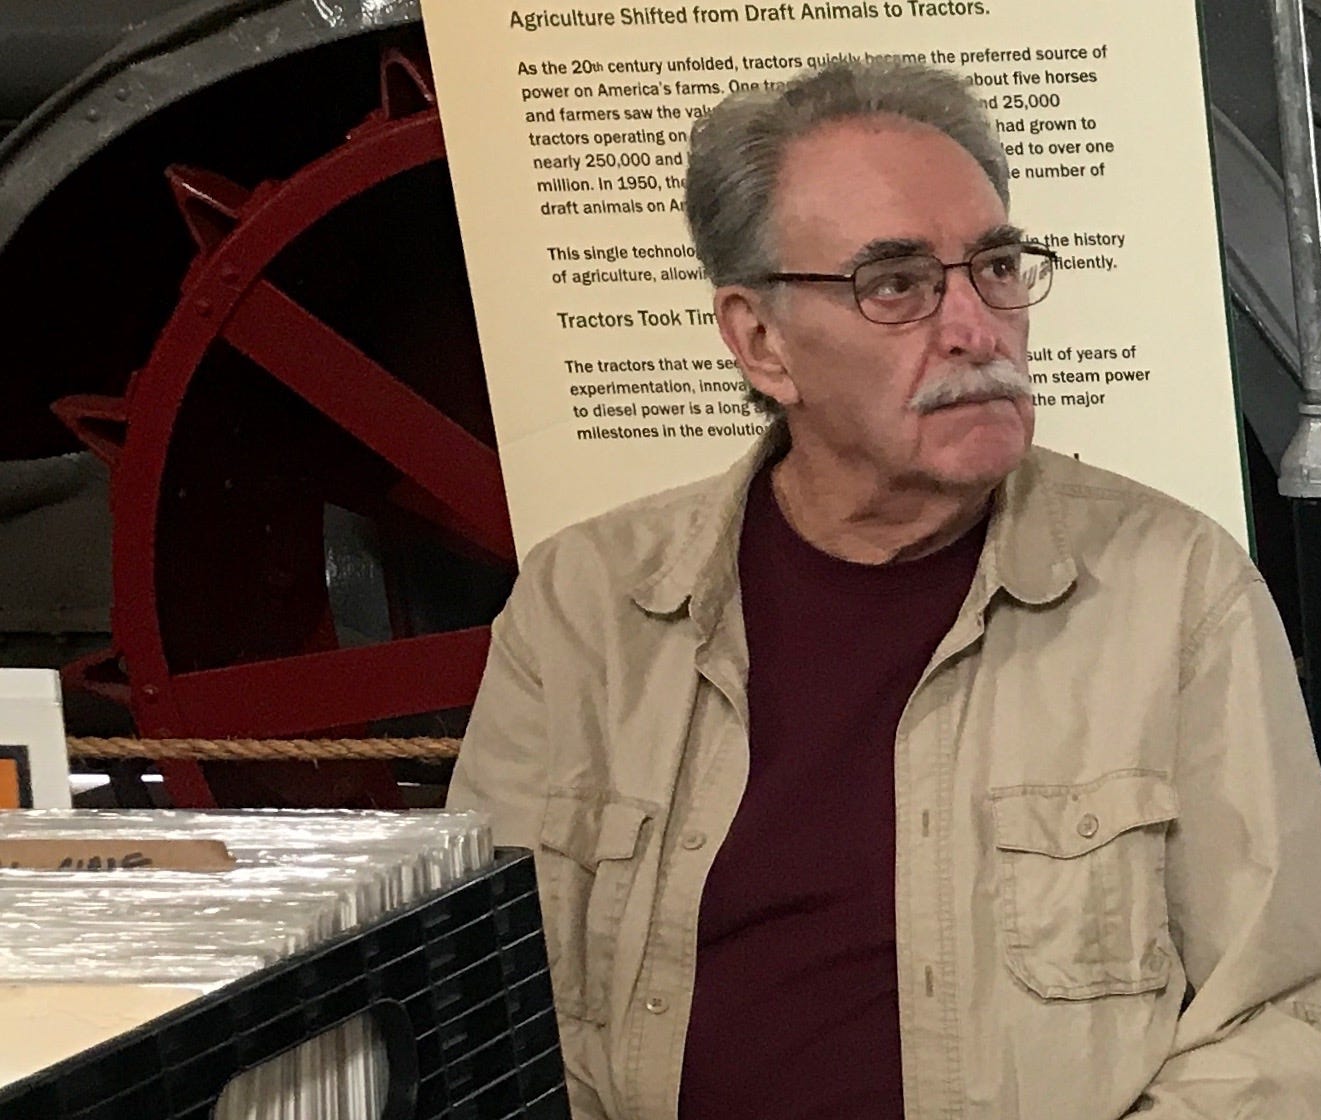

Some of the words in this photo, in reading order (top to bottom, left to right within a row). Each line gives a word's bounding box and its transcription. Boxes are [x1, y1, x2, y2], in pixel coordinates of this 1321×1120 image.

[510, 9, 615, 32] Agriculture
[620, 7, 687, 25] Shifted
[693, 6, 739, 23] from
[745, 3, 795, 21] Draft
[801, 1, 878, 20] Animals
[883, 2, 902, 17] to
[907, 0, 990, 16] Tractors.
[518, 62, 538, 75] As
[541, 61, 567, 75] the
[571, 60, 603, 74] 20th
[608, 60, 662, 75] century
[667, 56, 738, 72] unfolded,
[742, 56, 802, 70] tractors
[930, 50, 955, 64] the
[960, 47, 1031, 66] preferred
[1036, 48, 1087, 60] source
[1092, 44, 1107, 59] of
[522, 88, 569, 102] power
[574, 87, 593, 98] on
[598, 81, 672, 97] America's
[675, 81, 724, 95] farms.
[729, 80, 759, 94] One
[1012, 71, 1040, 85] five
[1045, 70, 1097, 84] horses
[526, 108, 555, 122] and
[559, 108, 620, 122] farmers
[624, 109, 652, 120] saw
[657, 105, 681, 119] the
[1003, 94, 1060, 110] 25,000
[529, 132, 589, 146] tractors
[594, 129, 665, 146] operating
[669, 132, 688, 142] on
[995, 119, 1025, 133] had
[1030, 119, 1077, 135] grown
[1081, 117, 1096, 130] to
[533, 155, 580, 171] nearly
[585, 153, 650, 168] 250,000
[656, 152, 683, 166] and
[1028, 142, 1044, 155] to
[1049, 143, 1081, 154] over
[1086, 142, 1114, 153] one
[537, 178, 594, 192] million.
[598, 177, 612, 191] In
[617, 176, 661, 191] 1950,
[1025, 164, 1085, 178] number
[1090, 162, 1105, 176] of
[541, 201, 579, 215] draft
[583, 199, 643, 214] animals
[647, 202, 665, 212] on
[547, 247, 580, 260] This
[584, 246, 628, 262] single
[1044, 234, 1069, 247] the
[1074, 233, 1125, 248] history
[552, 270, 566, 283] of
[572, 269, 656, 286] agriculture,
[557, 312, 634, 328] Tractors
[637, 309, 682, 326] Took
[564, 360, 593, 373] The
[597, 360, 655, 372] tractors
[658, 358, 688, 371] that
[692, 360, 712, 370] we
[1057, 347, 1072, 360] of
[1076, 349, 1117, 363] years
[1122, 345, 1136, 359] of
[570, 380, 695, 398] experimentation,
[1052, 371, 1100, 383] steam
[1105, 371, 1150, 384] power
[573, 406, 588, 418] to
[593, 403, 636, 417] diesel
[641, 405, 685, 418] power
[689, 402, 701, 414] is
[705, 404, 714, 414] a
[718, 399, 752, 416] long
[1032, 393, 1056, 407] the
[1061, 391, 1105, 407] major
[577, 426, 659, 440] milestones
[662, 424, 676, 437] in
[680, 424, 703, 437] the
